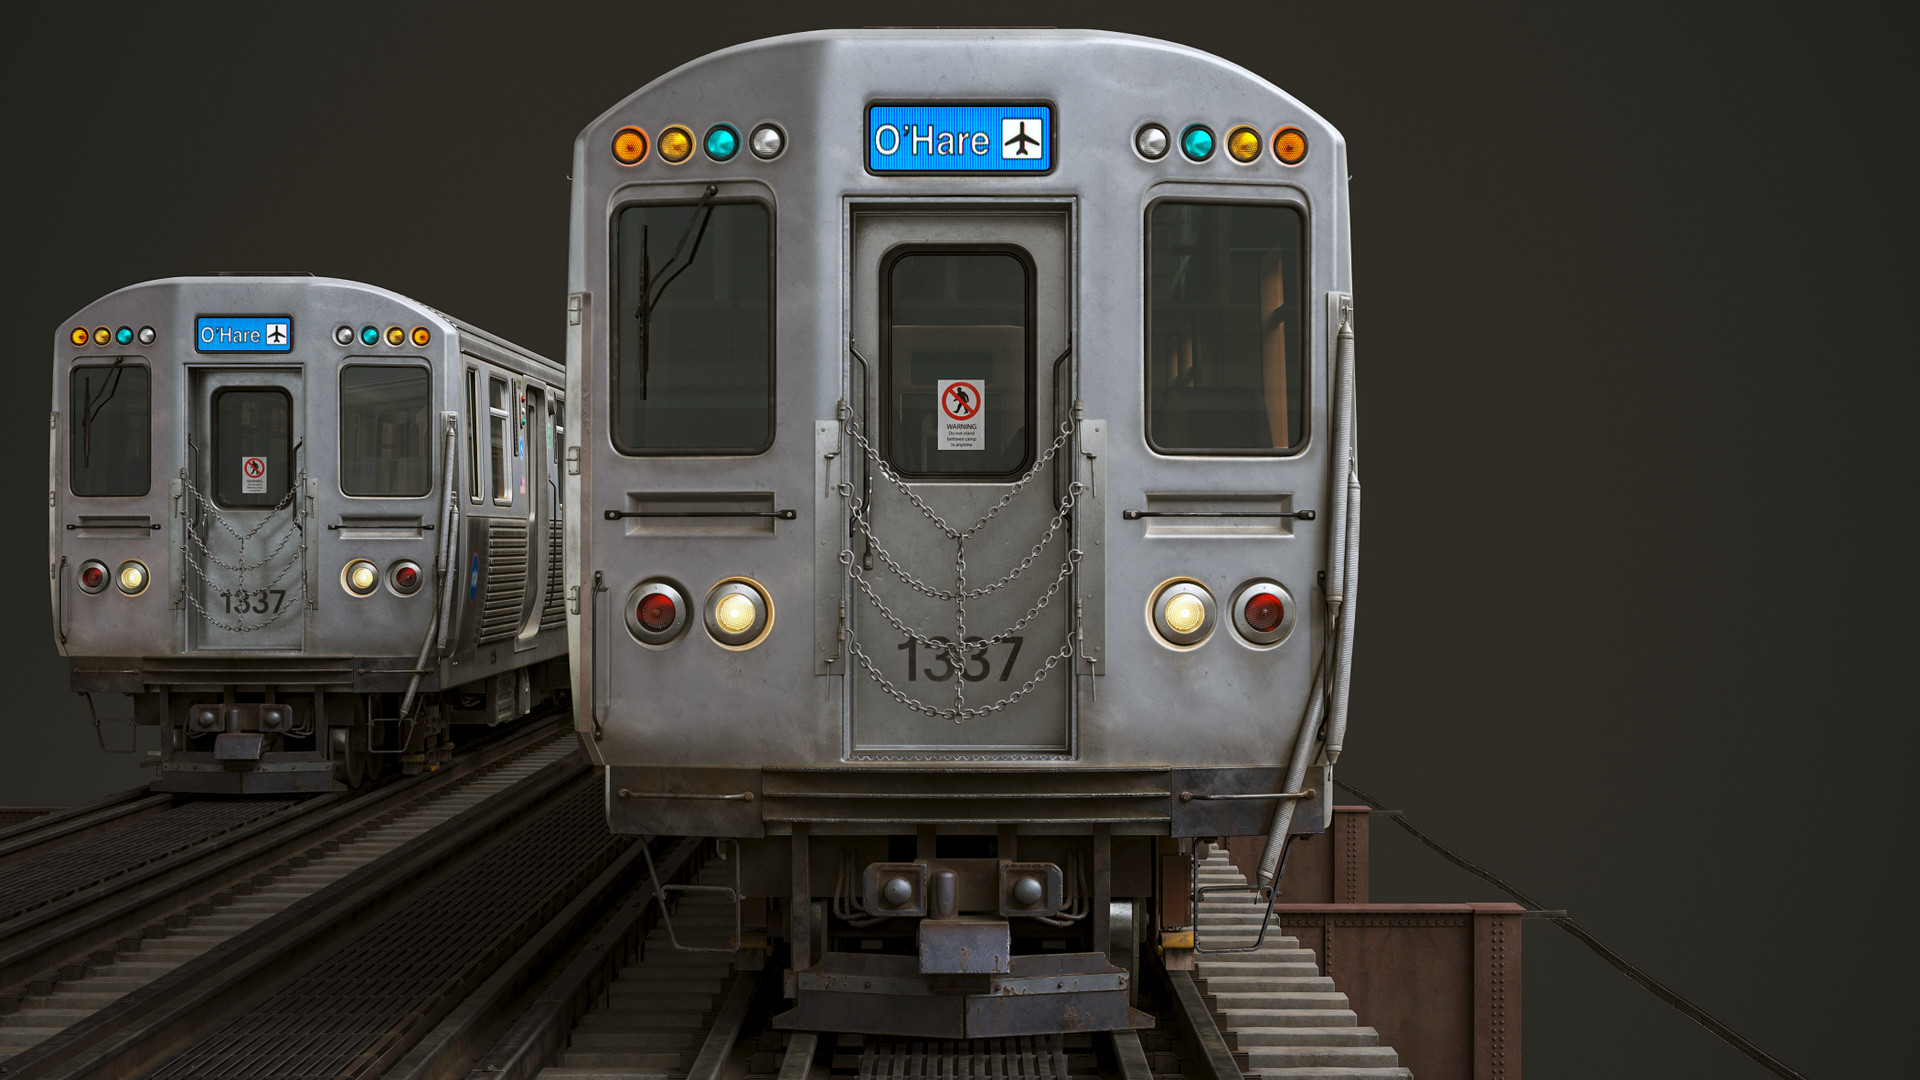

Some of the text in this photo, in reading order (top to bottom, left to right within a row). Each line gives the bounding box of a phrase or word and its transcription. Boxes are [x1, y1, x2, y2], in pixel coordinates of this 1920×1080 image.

[874, 123, 990, 156] O'Hare
[201, 326, 261, 343] O'Hare
[220, 589, 286, 614] 1337
[897, 635, 1023, 682] 1337
